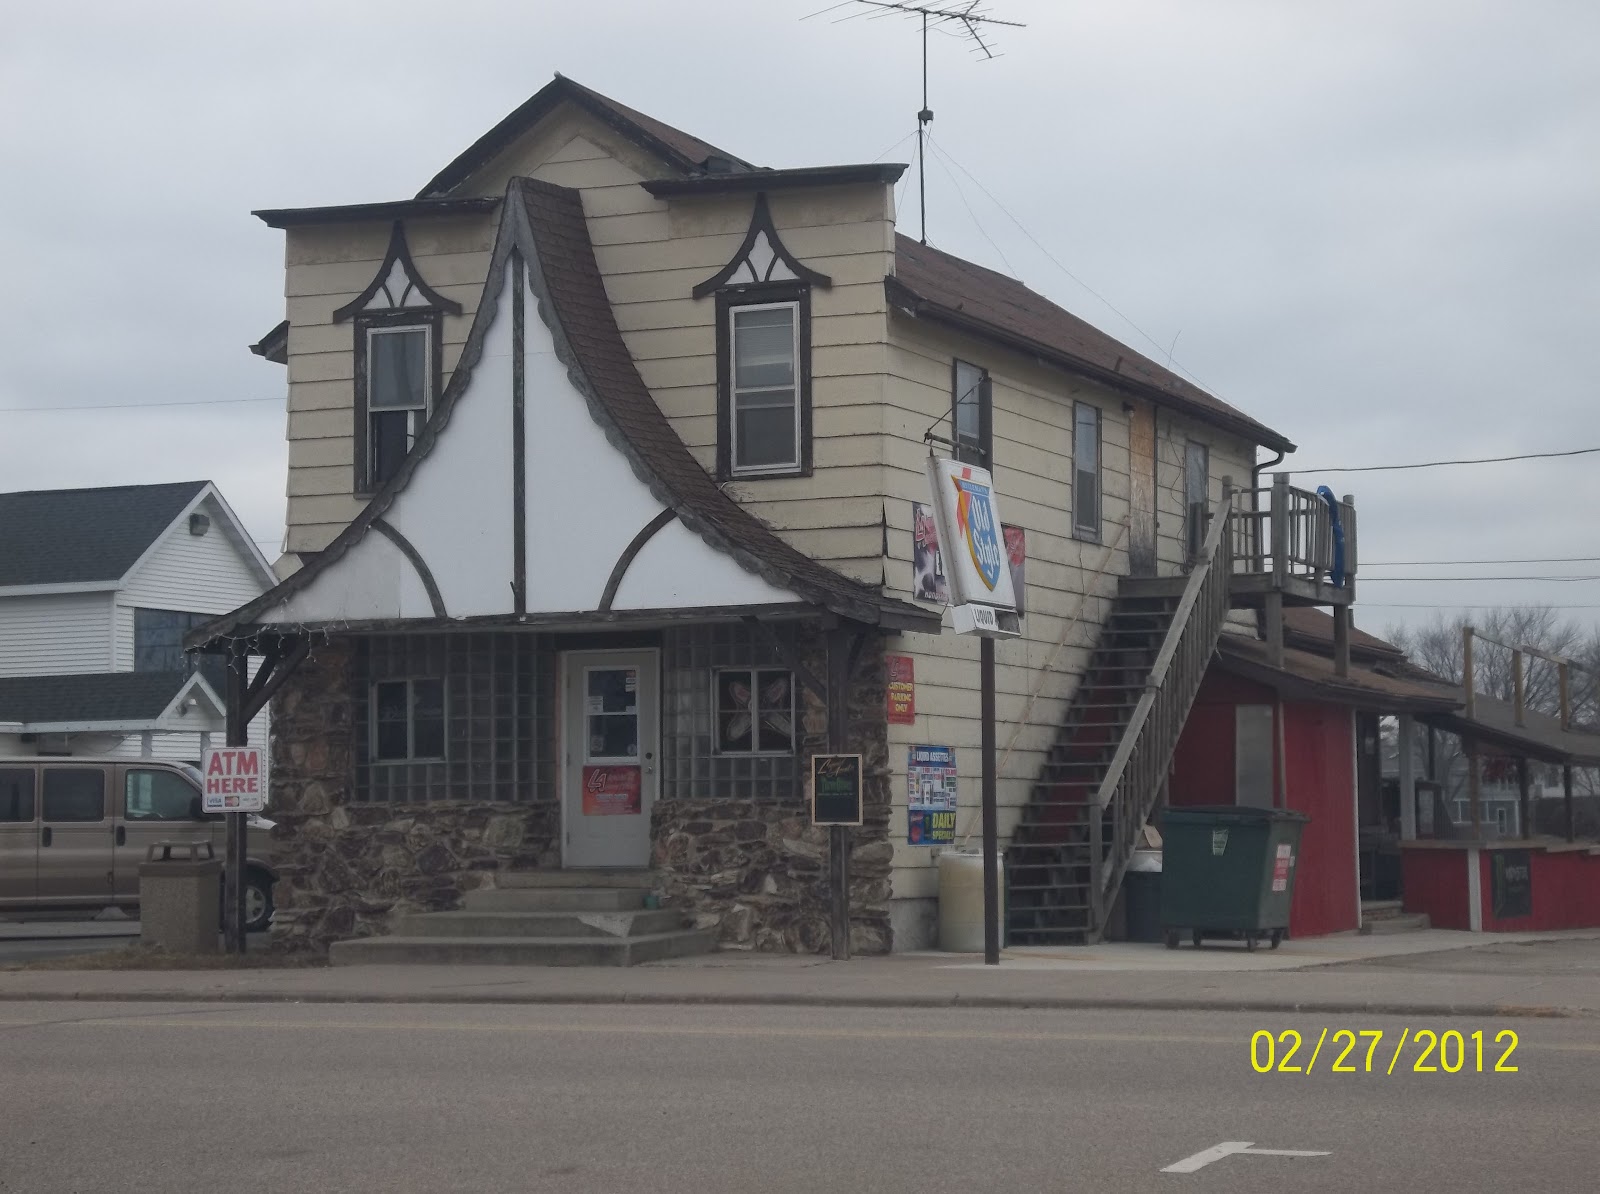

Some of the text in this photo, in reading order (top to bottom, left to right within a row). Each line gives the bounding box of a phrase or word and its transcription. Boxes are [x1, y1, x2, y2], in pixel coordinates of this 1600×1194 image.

[971, 496, 991, 532] Old
[973, 532, 1000, 579] Style
[974, 608, 994, 625] LIQUID
[888, 682, 914, 692] CUSTOMER
[891, 692, 912, 702] PARKING
[895, 703, 908, 712] ONLY
[207, 751, 259, 776] ATM
[916, 751, 930, 762] LIQUID
[207, 777, 259, 794] HERE
[932, 812, 956, 829] DAILY
